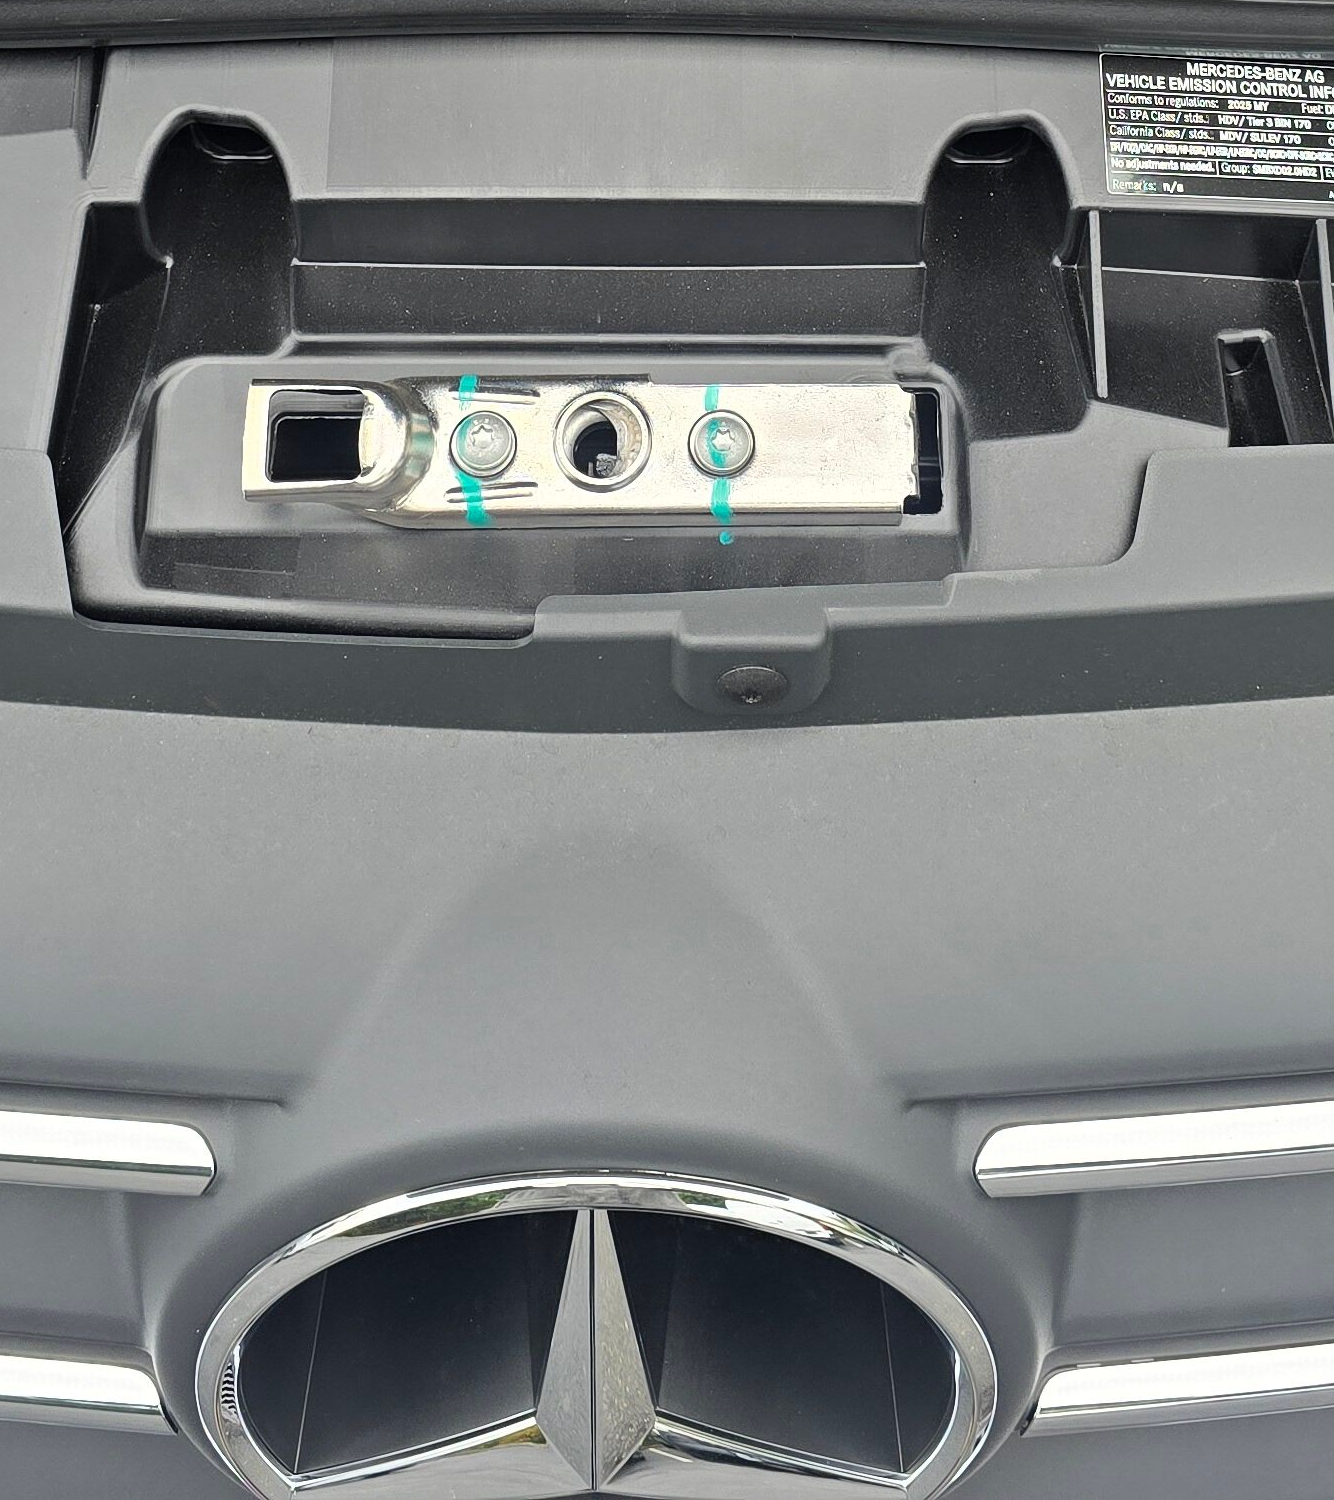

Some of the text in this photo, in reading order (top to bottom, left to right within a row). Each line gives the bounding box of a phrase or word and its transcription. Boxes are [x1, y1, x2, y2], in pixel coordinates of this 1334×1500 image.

[1187, 62, 1325, 84] MERCEDES-BENZ AG
[1106, 73, 1166, 90] VEHICLE
[1169, 76, 1237, 94] EMISSION
[1240, 81, 1307, 98] CONTROL
[1107, 93, 1269, 112] Conforms to regulations: 2025 MY
[1301, 103, 1324, 114] Fuel:
[1108, 109, 1129, 120] U.S.
[1130, 110, 1149, 121] EPA
[1247, 117, 1265, 127] Tier
[1294, 119, 1312, 130] 170
[1109, 125, 1153, 137] California
[1250, 132, 1281, 145] SULEV
[1283, 134, 1302, 145] 170
[1111, 158, 1215, 173] No adjustments needed.
[1220, 163, 1250, 176] Group:
[1112, 179, 1185, 194] Remarks: n/a
